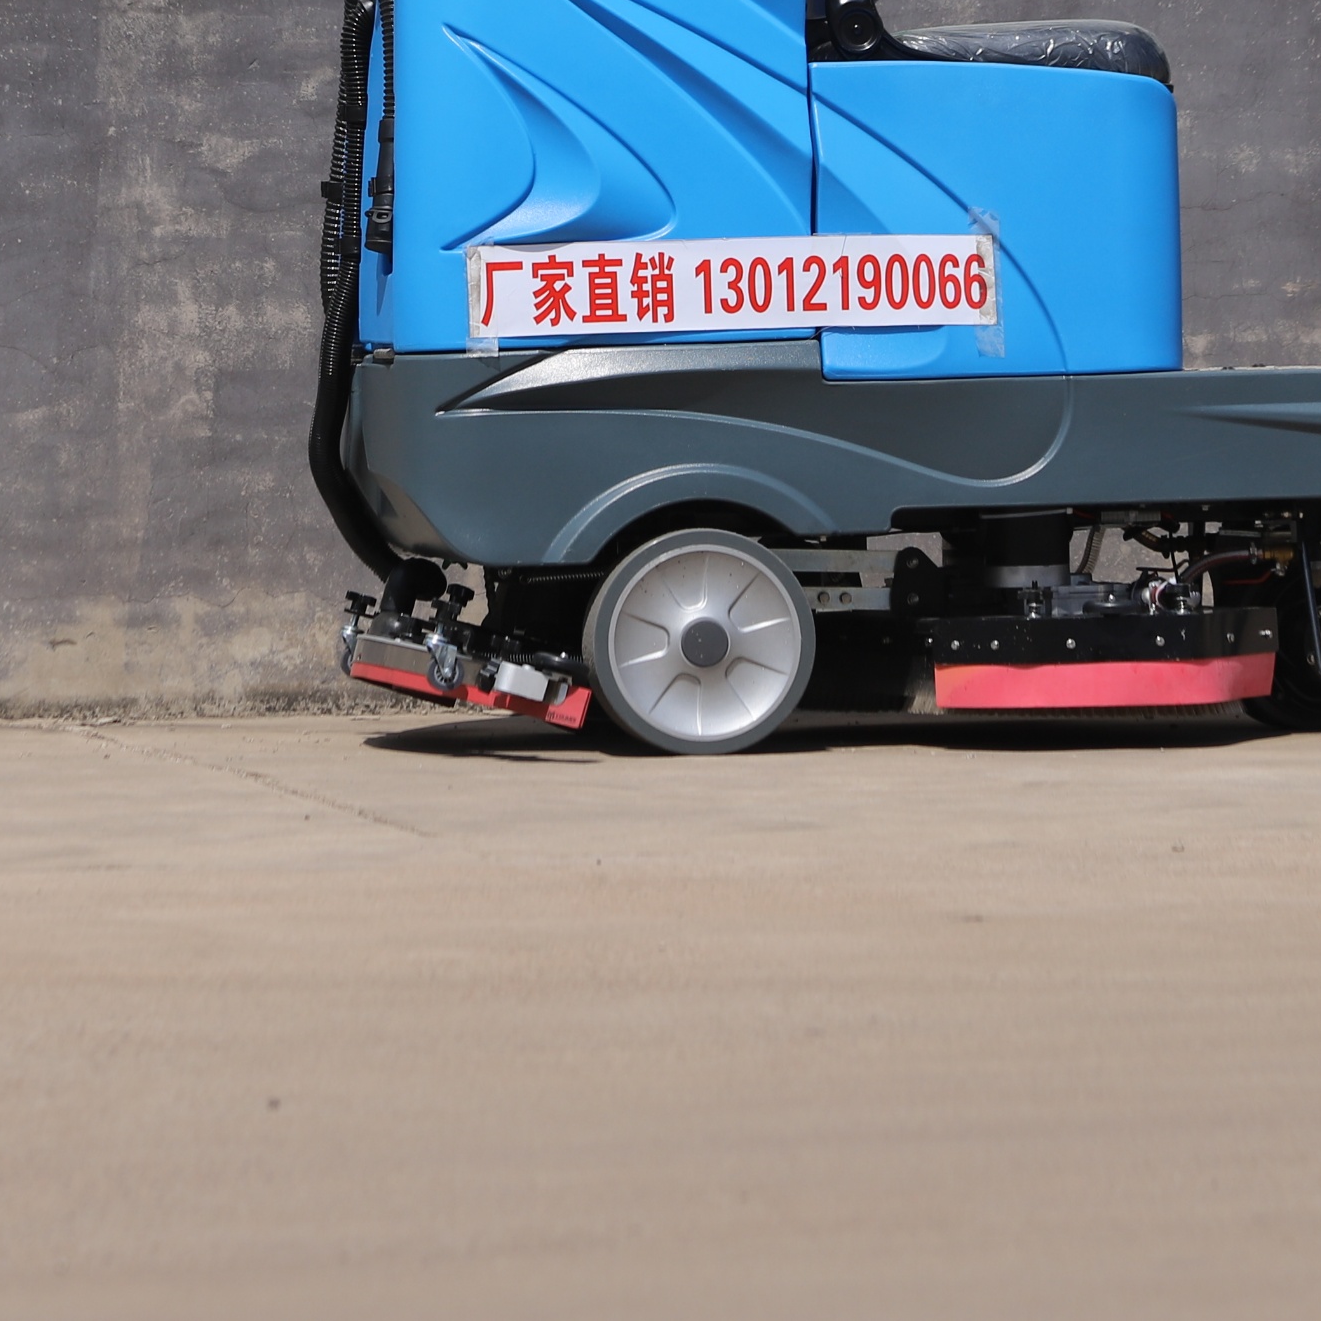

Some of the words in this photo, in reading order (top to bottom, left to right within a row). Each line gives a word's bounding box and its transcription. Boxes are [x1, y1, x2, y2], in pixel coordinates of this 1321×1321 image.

[480, 251, 674, 328] 厂家直销
[694, 252, 988, 315] 13012190066
